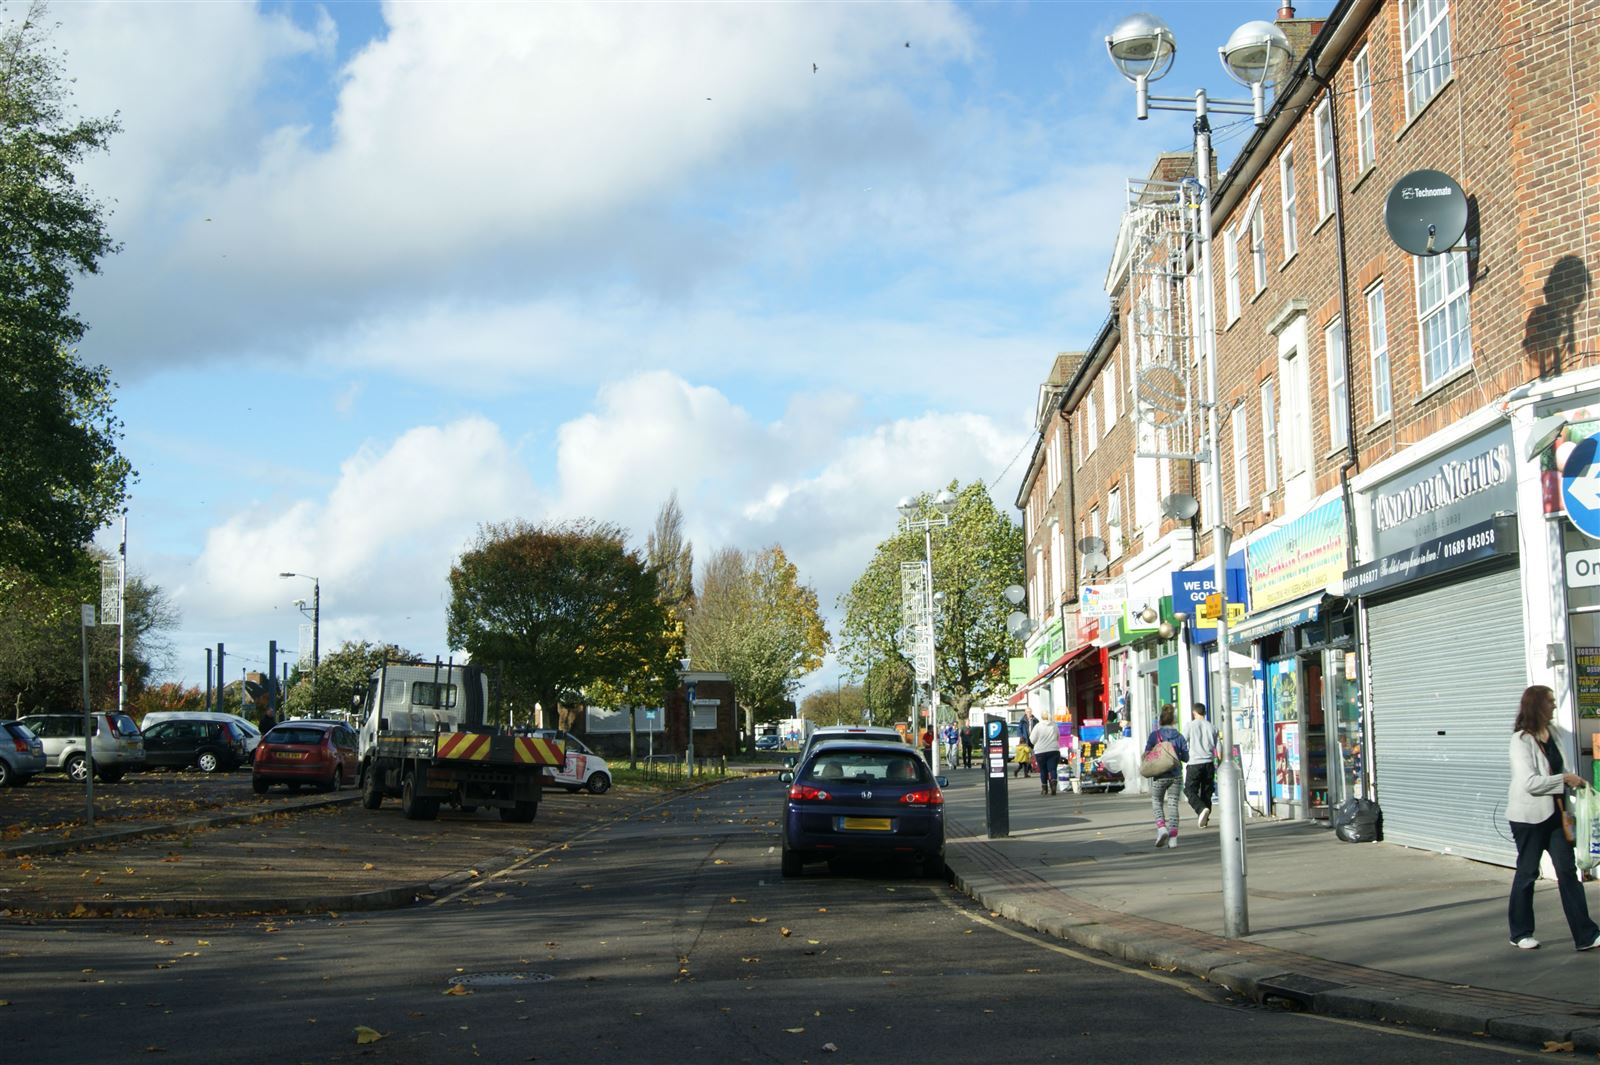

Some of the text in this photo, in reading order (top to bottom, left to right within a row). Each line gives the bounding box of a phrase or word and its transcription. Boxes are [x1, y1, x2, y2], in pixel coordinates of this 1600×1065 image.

[1414, 186, 1452, 198] Technomate
[1439, 444, 1510, 505] NIGHTS
[1444, 529, 1495, 558] 01689 843058
[1183, 581, 1217, 590] WE BU
[989, 722, 999, 736] P
